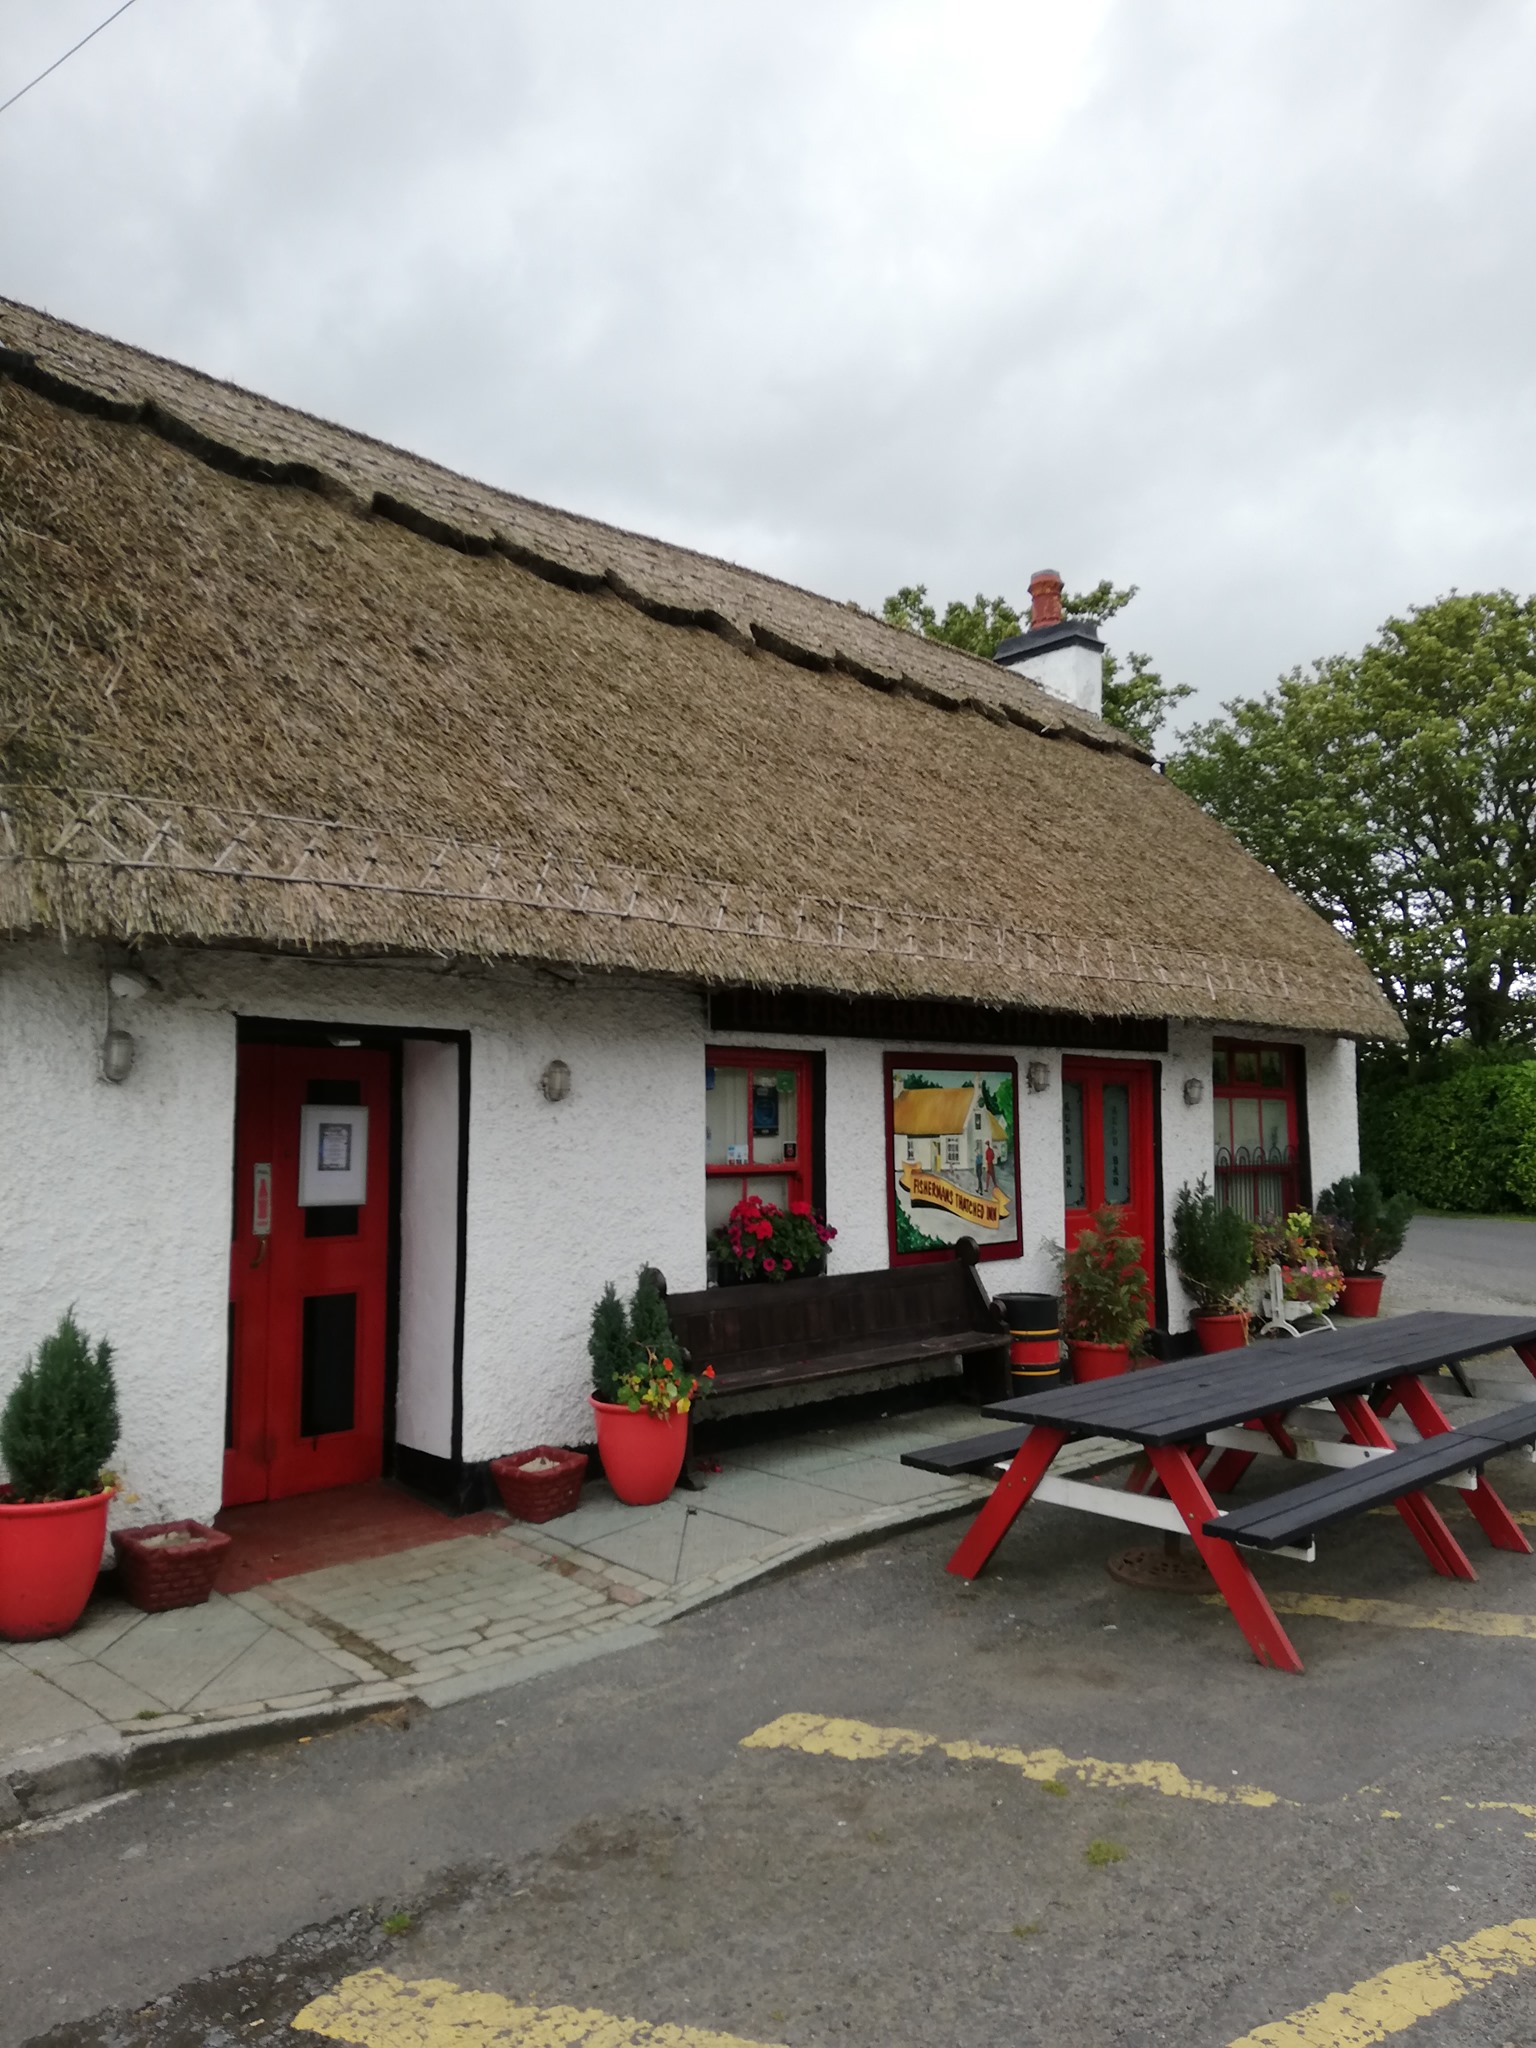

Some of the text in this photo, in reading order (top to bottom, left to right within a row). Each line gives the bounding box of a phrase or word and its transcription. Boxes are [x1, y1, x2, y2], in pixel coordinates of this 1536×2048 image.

[913, 1178, 997, 1221] FISHERMANS THATCHED INN
